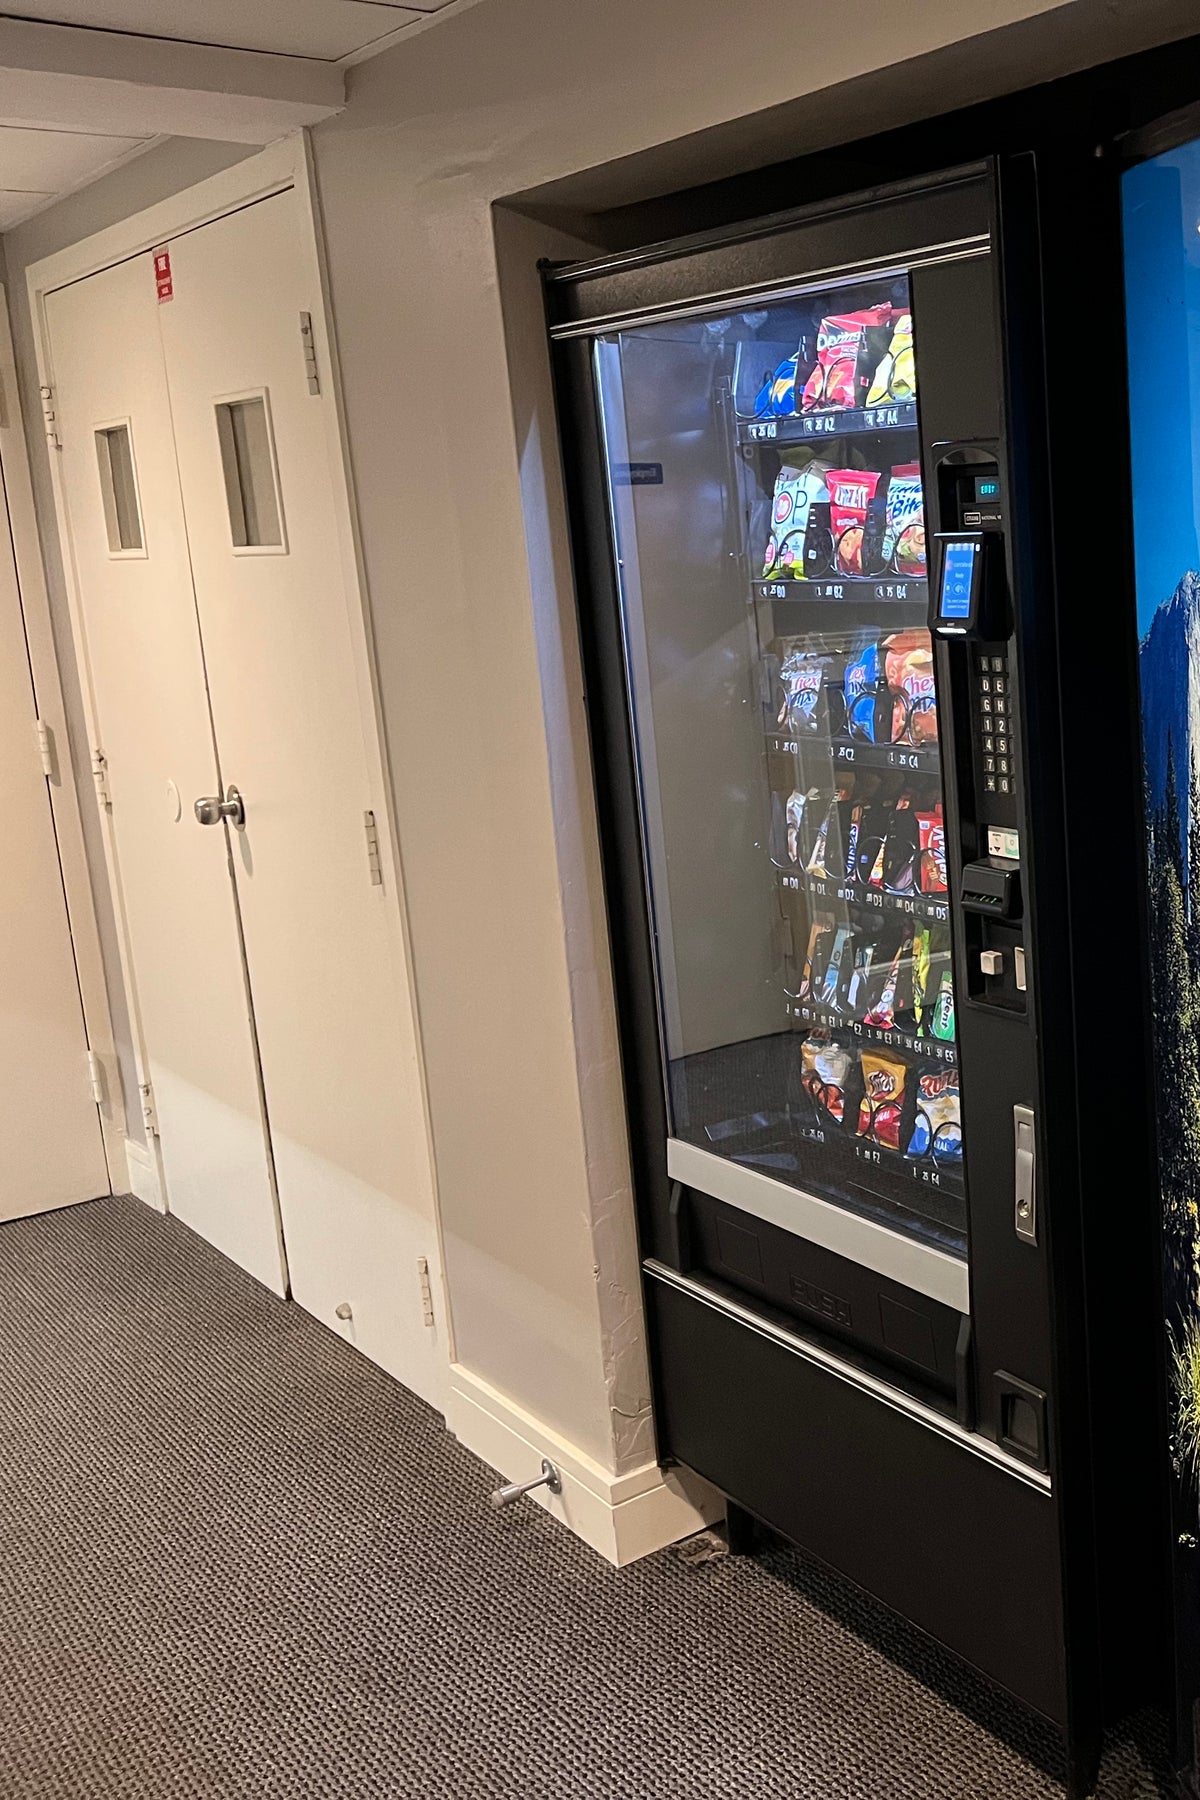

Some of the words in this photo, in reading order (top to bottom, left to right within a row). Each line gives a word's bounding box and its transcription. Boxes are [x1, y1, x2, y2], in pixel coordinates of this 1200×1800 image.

[887, 410, 898, 424] A4
[824, 418, 835, 432] A2
[834, 585, 843, 598] B2
[896, 585, 906, 598] B4
[983, 680, 988, 690] D
[997, 681, 1002, 692] E
[984, 699, 990, 710] G
[998, 701, 1003, 712] H
[986, 720, 990, 730] 1
[999, 720, 1004, 731] 2
[986, 739, 991, 750] 4
[1000, 740, 1005, 751] 5
[846, 748, 855, 761] C2
[909, 755, 918, 768] C4
[988, 760, 992, 770] 7
[1001, 760, 1006, 771] 8
[1002, 780, 1007, 791] 0
[845, 889, 854, 901] D2
[874, 894, 882, 907] D3
[905, 900, 914, 913] D4
[936, 907, 946, 920] D5
[854, 1023, 862, 1036] E2
[885, 1033, 892, 1045] E3
[914, 1041, 922, 1054] E4
[945, 1049, 953, 1062] E5
[873, 1151, 880, 1164] F2
[932, 1173, 939, 1186] F4
